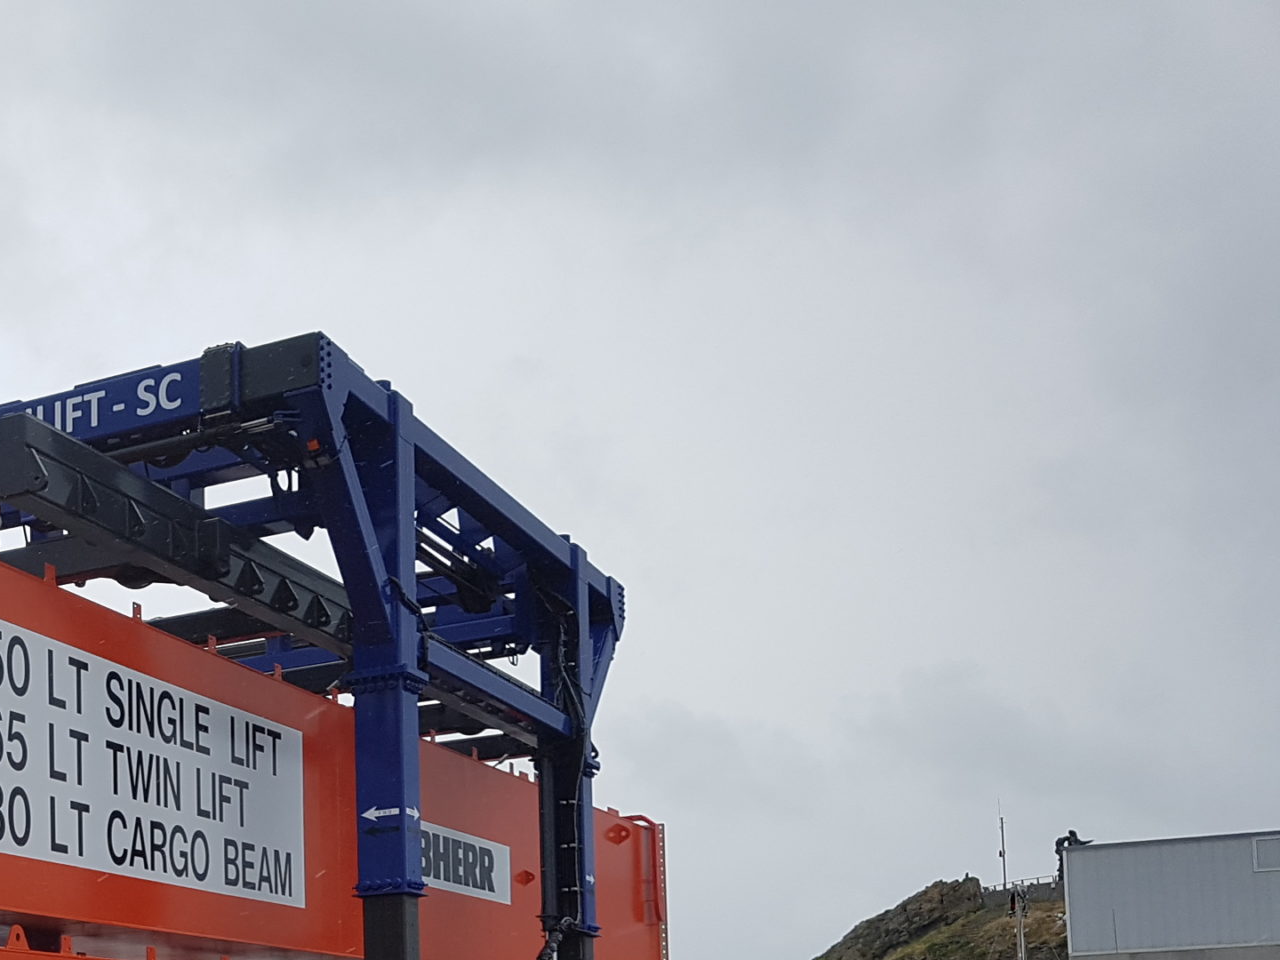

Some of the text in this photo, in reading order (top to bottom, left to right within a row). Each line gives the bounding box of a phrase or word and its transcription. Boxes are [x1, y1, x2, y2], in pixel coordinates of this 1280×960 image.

[136, 373, 182, 416] SC
[47, 648, 89, 715] LT
[105, 670, 210, 756] SINGLE
[230, 715, 282, 776] LIFT
[48, 722, 90, 786] LT
[105, 739, 181, 811] TWIN
[196, 767, 249, 828] LIFT
[49, 795, 90, 857] LT
[107, 809, 210, 882] CARGO
[223, 837, 293, 898] BEAM
[420, 829, 495, 893] BHERR
